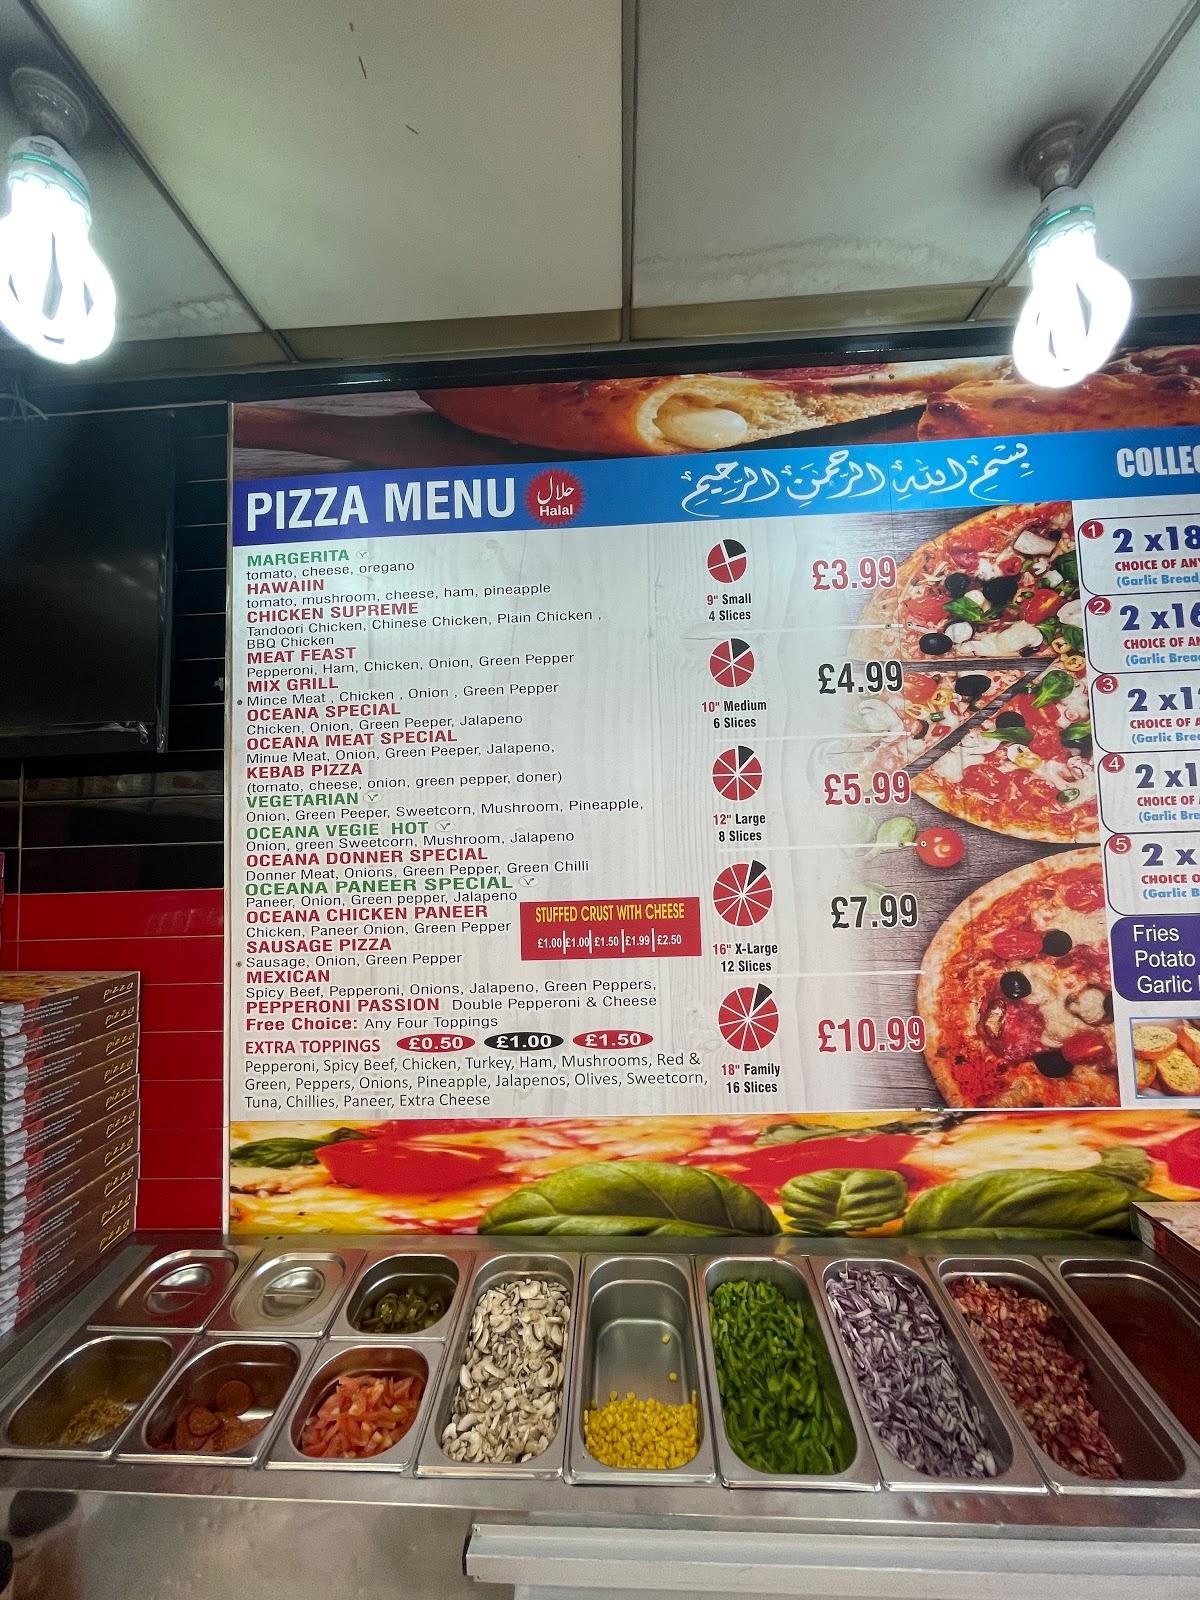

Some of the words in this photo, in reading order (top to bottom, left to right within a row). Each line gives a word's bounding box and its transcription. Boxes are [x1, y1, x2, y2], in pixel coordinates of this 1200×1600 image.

[538, 476, 574, 505] حلال
[247, 485, 368, 531] PIZZA
[385, 478, 515, 522] MENU
[539, 505, 573, 516] Halal
[1091, 524, 1096, 537] 1
[1112, 528, 1133, 553] 2
[247, 550, 349, 567] MARGERITA
[1115, 561, 1158, 571] CHOICE
[1162, 559, 1176, 569] OF
[812, 557, 896, 590] £3.99
[1117, 575, 1158, 588] (Garlic
[247, 579, 324, 595] HAWAIIN
[246, 596, 296, 609] tomato,
[302, 592, 379, 606] mushroom,
[385, 589, 438, 602] cheese,
[444, 587, 478, 599] ham,
[484, 583, 550, 599] pineapple
[722, 593, 751, 604] Small
[246, 607, 323, 623] CHICKEN
[330, 602, 418, 619] SUPREME
[709, 611, 715, 621] 4
[719, 609, 751, 621] Slices
[1094, 601, 1105, 614] 2
[1120, 605, 1139, 631] 2
[246, 637, 275, 652] BBQ
[280, 634, 334, 648] Chicken
[1124, 639, 1165, 649] CHOICE
[1170, 638, 1184, 648] OF
[247, 650, 293, 664] MEAT
[300, 647, 354, 662] FEAST
[1126, 654, 1165, 666] (Garlic
[247, 664, 317, 681] Pepperoni,
[323, 662, 358, 674] Ham,
[364, 659, 422, 672] Chicken,
[428, 656, 472, 669] Onion,
[478, 654, 519, 667] Green
[525, 651, 576, 667] Pepper
[247, 679, 280, 692] MIX
[286, 676, 340, 691] GRILL
[818, 662, 903, 694] £4.99
[1103, 678, 1113, 691] 3
[724, 698, 767, 710] Medium
[1128, 688, 1147, 712] 2
[247, 706, 319, 722] OCEANA
[325, 703, 402, 718] SPECIAL
[713, 719, 720, 729] 6
[724, 716, 756, 727] Slices
[1130, 719, 1172, 728] CHOICE
[1176, 718, 1191, 728] OF
[246, 735, 319, 750] OCEANA
[325, 733, 372, 747] MEAT
[380, 729, 459, 744] SPECIAL
[1132, 734, 1173, 744] (Garlic
[246, 764, 304, 779] KEBAB
[311, 763, 362, 777] PIZZA
[1109, 757, 1120, 770] 4
[246, 780, 303, 795] (tomato,
[309, 778, 362, 791] cheese,
[367, 779, 409, 789] onion,
[415, 777, 454, 790] green
[460, 776, 510, 788] pepper,
[516, 772, 562, 787] doner)
[1135, 764, 1154, 788] 2
[824, 771, 910, 805] £5.99
[247, 792, 358, 808] VEGETARIAN
[1137, 797, 1176, 806] CHOICE
[1181, 796, 1195, 805] OF
[735, 812, 766, 826] Large
[1139, 812, 1176, 822] (Garlic
[246, 824, 319, 839] OCEANA
[326, 823, 379, 837] VEGIE
[391, 821, 427, 835] HOT
[719, 831, 725, 842] 8
[729, 829, 762, 841] Slices
[1116, 838, 1127, 851] 5
[246, 852, 320, 867] OCEANA
[326, 850, 403, 865] DONNER
[409, 847, 490, 862] SPECIAL
[1142, 844, 1163, 866] 2
[244, 881, 328, 896] OCEANA
[335, 878, 416, 893] PANEER
[424, 876, 515, 891] SPECIAL
[1142, 875, 1188, 884] CHOICE
[1143, 888, 1187, 899] (Garlic
[246, 909, 320, 924] OCEANA
[326, 907, 407, 922] CHICKEN
[414, 905, 488, 920] PANEER
[535, 906, 578, 923] STUFFED
[580, 905, 614, 922] CRUST
[616, 904, 642, 921] WITH
[644, 903, 684, 920] CHEESE
[831, 895, 917, 929] £7.99
[538, 936, 562, 948] £1.00
[566, 935, 590, 948] £1.00
[594, 935, 619, 947] £1.50
[625, 934, 650, 946] £1.99
[657, 934, 681, 945] £2.50
[1133, 925, 1179, 941] Fries
[246, 939, 332, 953] SAUSAGE
[339, 938, 391, 952] PIZZA
[735, 941, 778, 956] X-Large
[721, 961, 734, 972] 12
[738, 960, 771, 971] Slices
[1136, 951, 1195, 968] Potato
[246, 969, 329, 984] MEXICAN
[1138, 976, 1192, 993] Garlic
[104, 982, 134, 999] pizza
[245, 987, 284, 1001] Spicy
[289, 986, 323, 999] Beef,
[329, 984, 403, 1000] Pepperoni,
[409, 983, 463, 996] Onions,
[469, 981, 538, 996] Jalapeno,
[544, 980, 586, 992] Green
[592, 978, 656, 994] Peppers,
[246, 999, 350, 1013] PEPPERONI
[357, 998, 439, 1012] PASSION
[452, 998, 502, 1010] Double
[508, 996, 580, 1012] Pepperoni
[586, 996, 597, 1007] &
[602, 995, 656, 1007] Cheese
[246, 1017, 284, 1031] Free
[291, 1016, 357, 1030] Choice:
[363, 1017, 392, 1032] Any
[397, 1016, 430, 1029] Four
[435, 1014, 498, 1031] Toppings
[106, 1032, 135, 1052] pizza
[408, 1035, 463, 1050] £0.50
[496, 1034, 552, 1048] £1.00
[585, 1033, 641, 1046] £1.50
[818, 1017, 924, 1052] £10.99
[245, 1039, 295, 1054] EXTRA
[301, 1038, 380, 1053] TOPPINGS
[744, 1063, 780, 1079] Family
[726, 1082, 740, 1092] 16
[744, 1080, 777, 1093] Slices
[106, 1084, 135, 1106] pizza
[107, 1111, 135, 1134] pizza
[104, 1167, 134, 1191] pizza
